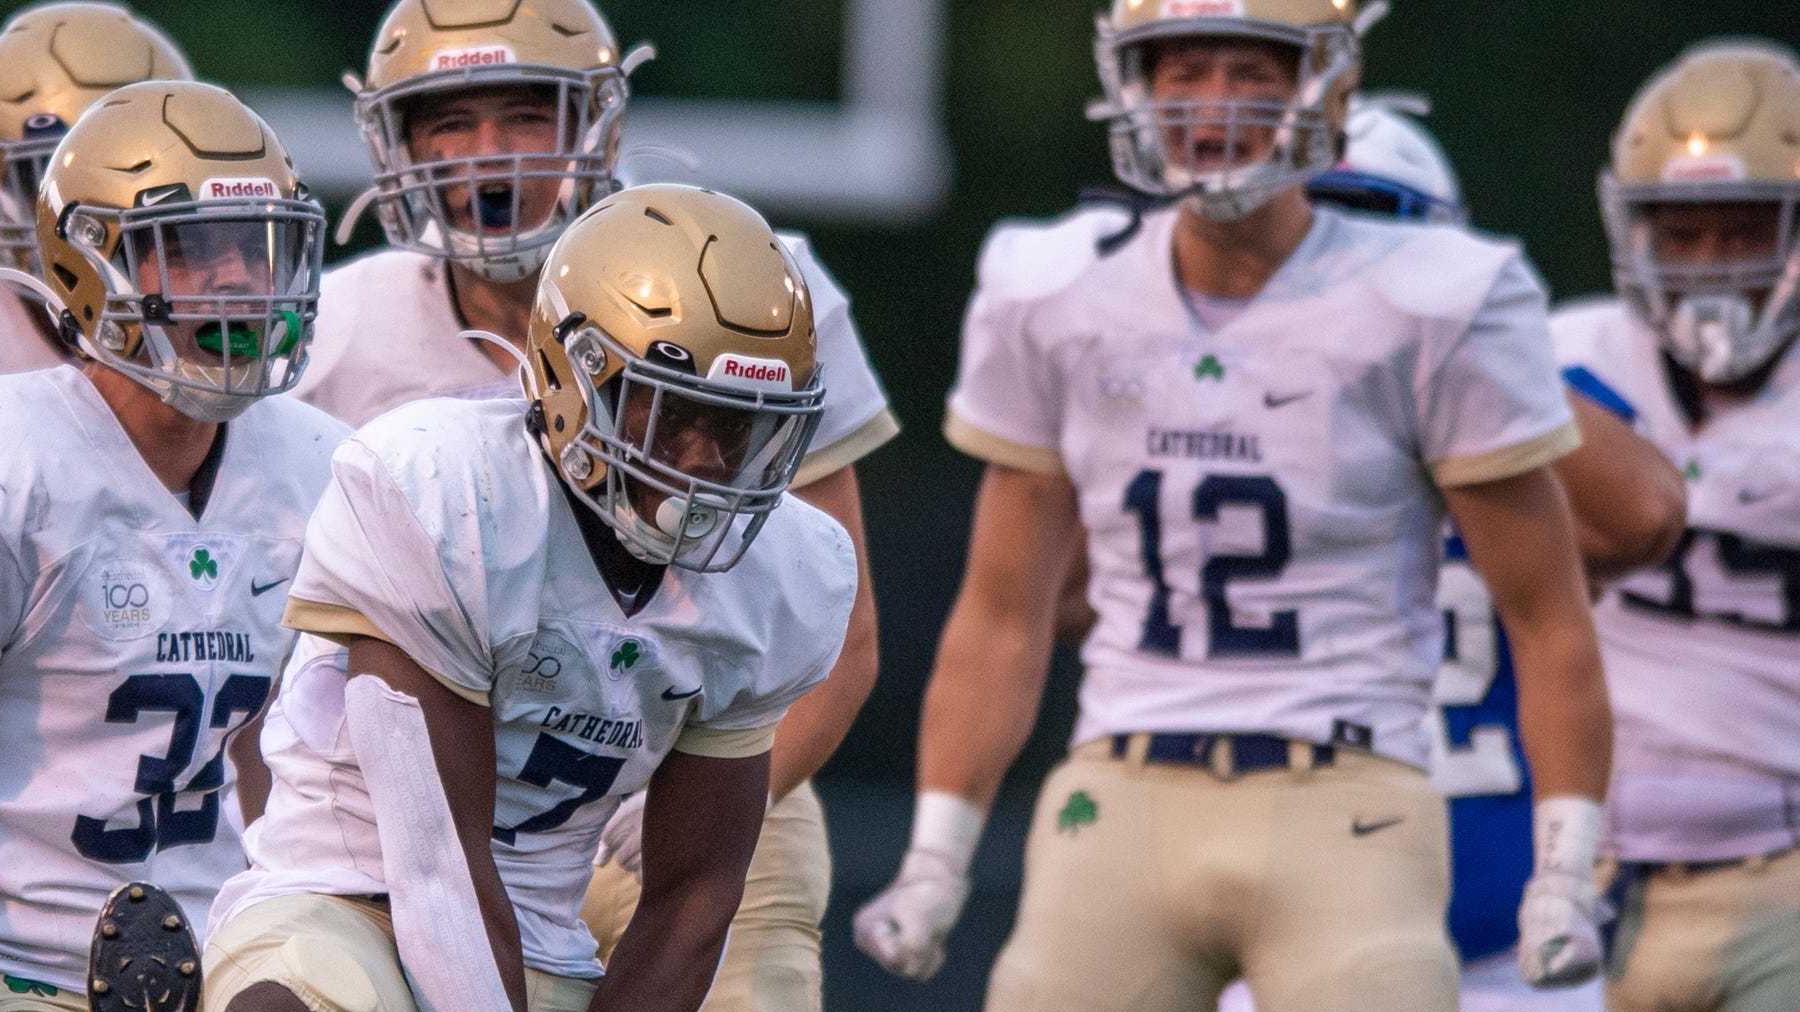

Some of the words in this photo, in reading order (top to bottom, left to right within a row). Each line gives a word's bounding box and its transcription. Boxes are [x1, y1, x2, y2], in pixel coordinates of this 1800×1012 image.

[438, 50, 506, 69] Riddell
[210, 182, 274, 197] Riddell
[724, 359, 787, 382] Riddell
[1147, 428, 1263, 463] CATHEDRAL
[1121, 468, 1303, 660] 12
[102, 583, 149, 610] 100
[103, 608, 151, 624] YEARS
[156, 630, 255, 663] CATHEDRAL
[540, 705, 644, 749] CATHEDRAL
[70, 672, 273, 865] 32
[493, 730, 628, 847] 7
